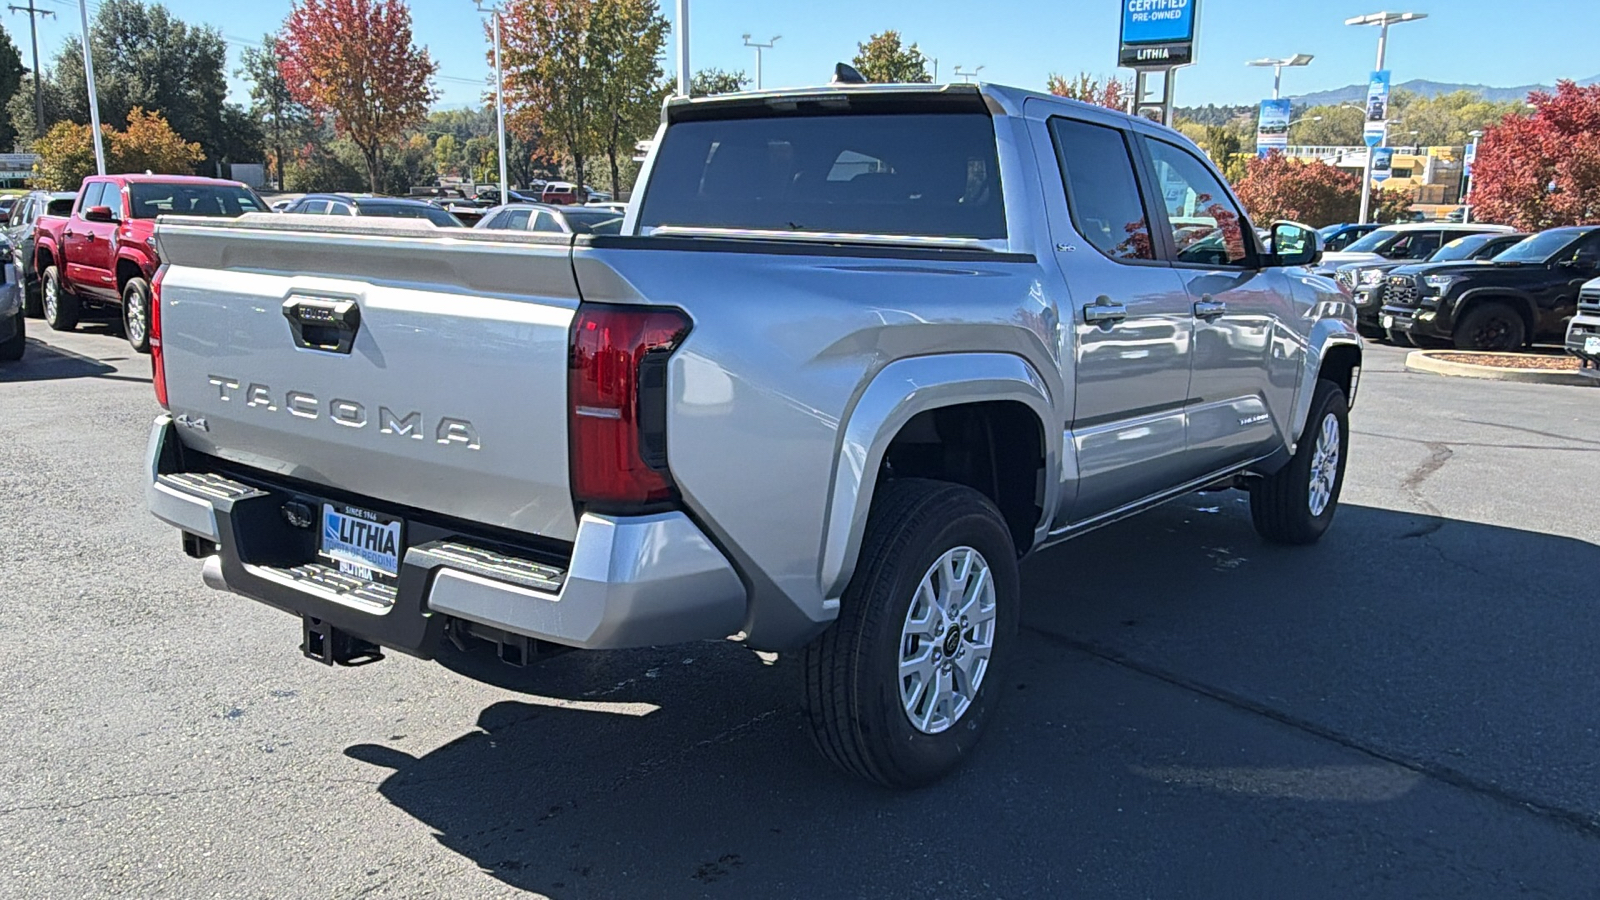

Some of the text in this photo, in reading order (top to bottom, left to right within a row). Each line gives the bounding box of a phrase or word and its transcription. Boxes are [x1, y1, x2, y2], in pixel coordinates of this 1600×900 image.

[1128, 0, 1187, 12] CERTIFIED
[1132, 10, 1181, 22] PRE-OWNED
[1137, 48, 1169, 60] LITHIA
[208, 374, 480, 450] TACOMA
[345, 506, 377, 521] SINCE 1946
[340, 516, 397, 557] LITHIA
[351, 546, 361, 558] OF
[361, 550, 397, 569] REDDING
